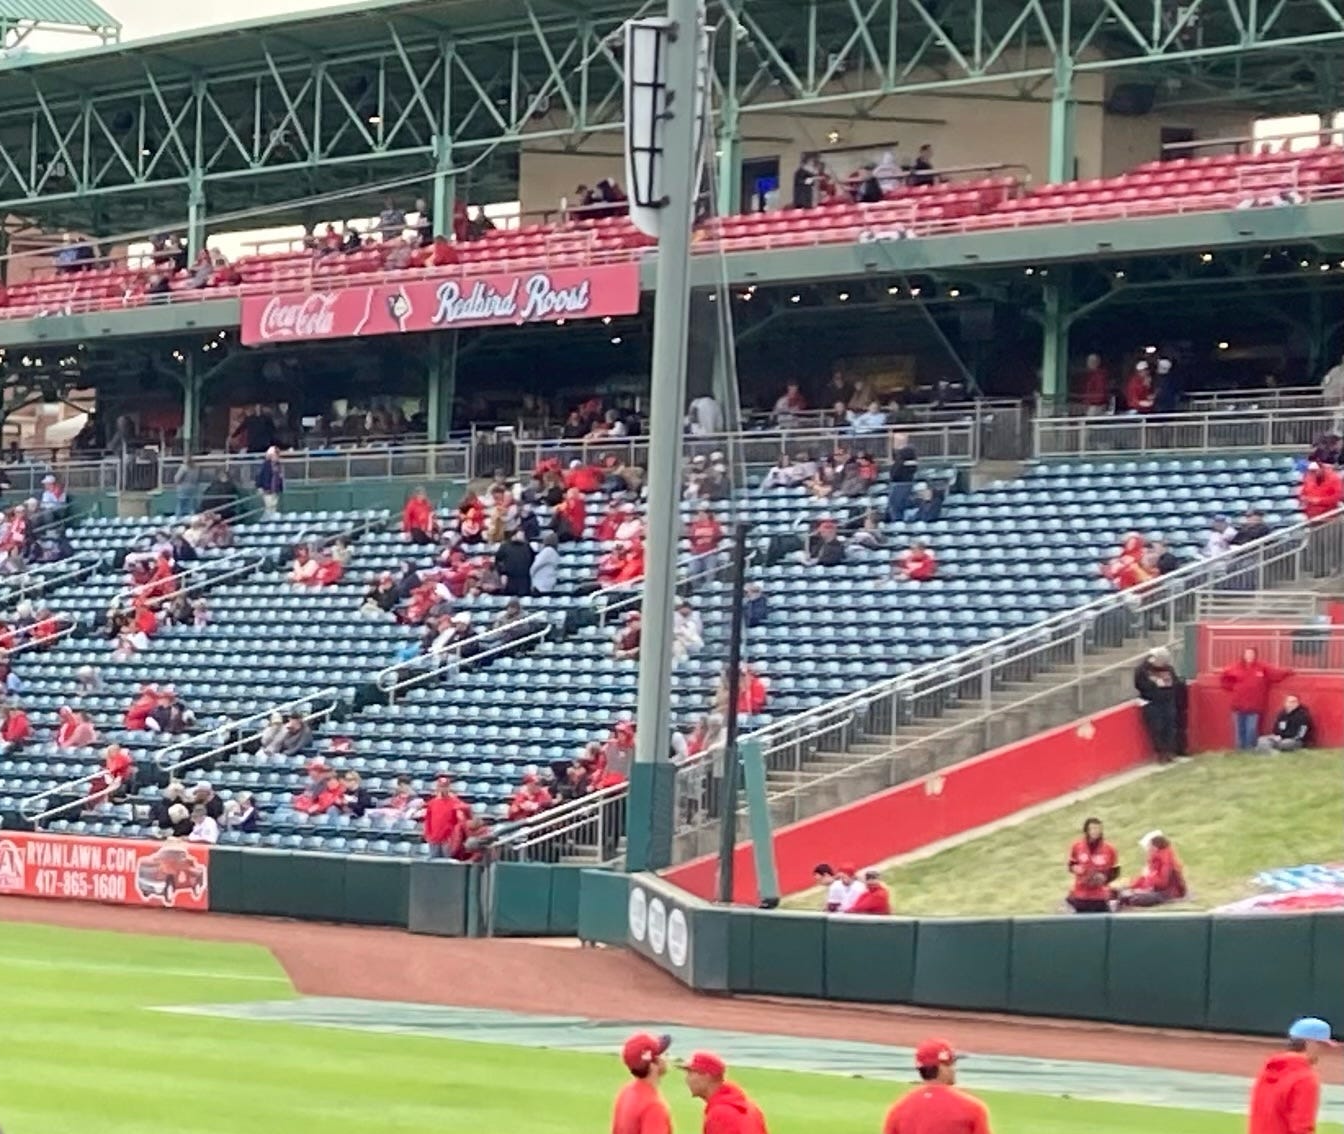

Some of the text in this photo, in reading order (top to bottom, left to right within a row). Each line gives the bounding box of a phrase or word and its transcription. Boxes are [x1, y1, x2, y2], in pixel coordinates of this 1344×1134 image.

[431, 273, 590, 325] Redbird Roost
[25, 840, 137, 873] RYANLAWN.COM
[34, 868, 127, 900] 417-865-1600
